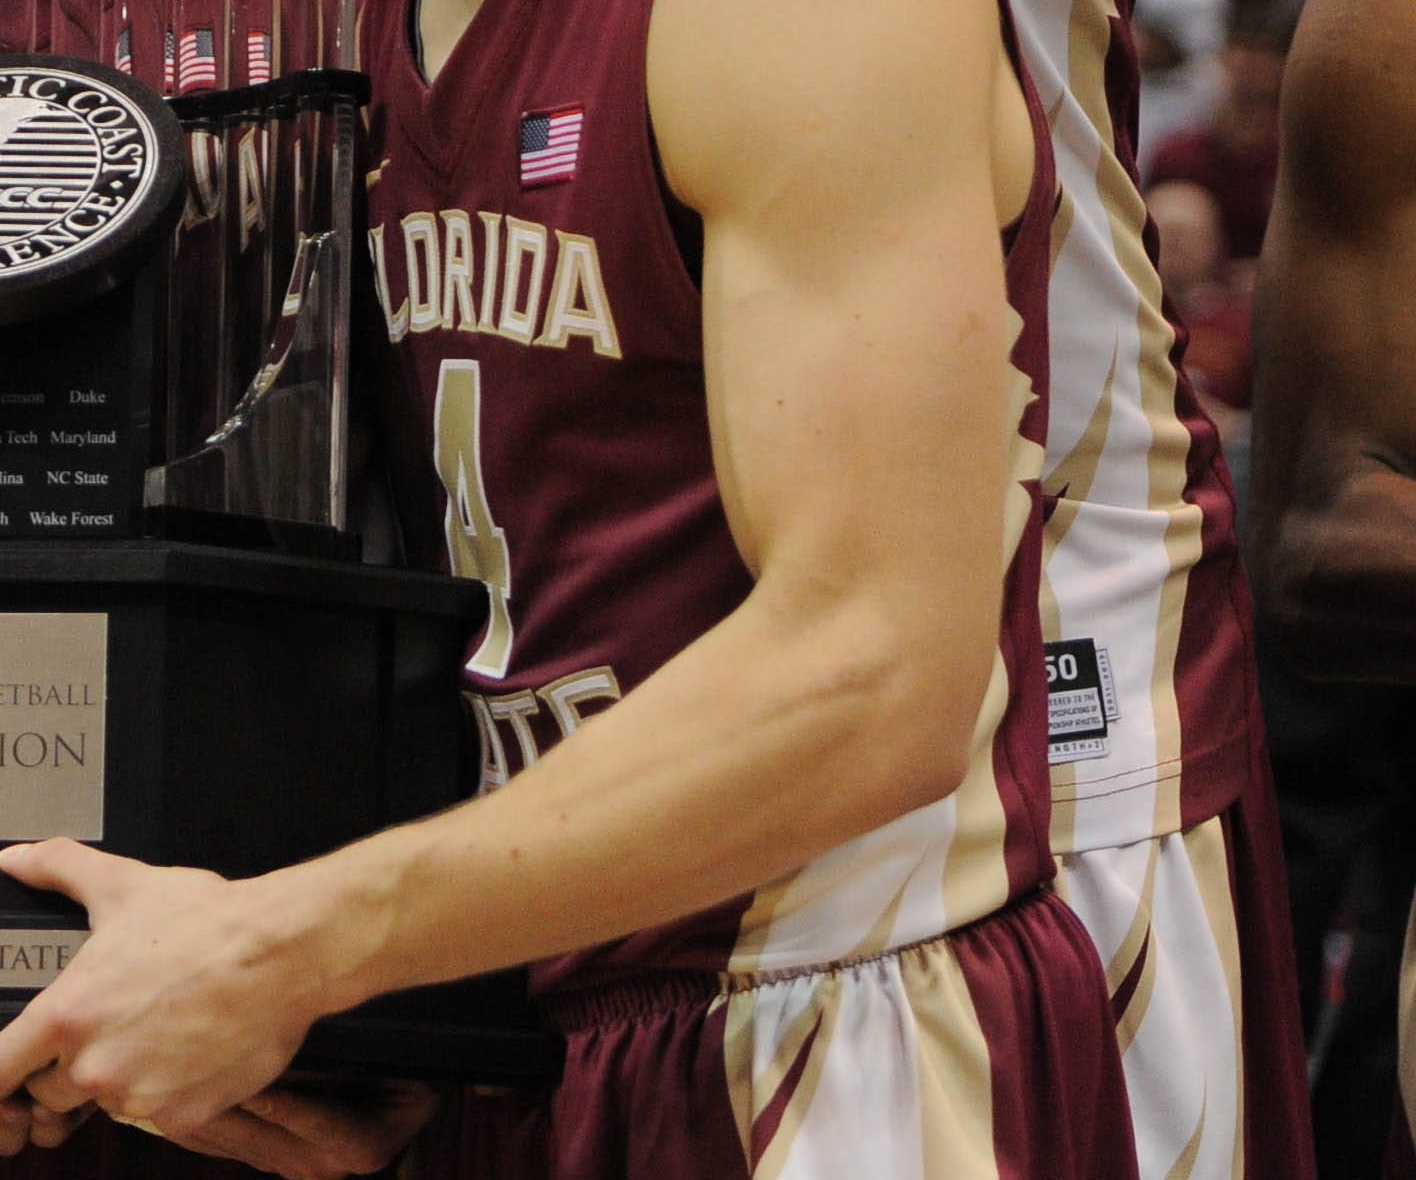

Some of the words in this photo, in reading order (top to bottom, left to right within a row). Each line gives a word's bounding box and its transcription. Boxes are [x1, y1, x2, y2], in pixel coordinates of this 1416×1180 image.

[68, 91, 143, 178] COAST
[368, 210, 623, 359] LORIDA
[70, 389, 106, 404] Duke
[6, 431, 38, 445] Tech
[50, 430, 116, 447] Maryland
[47, 471, 71, 485] NC
[74, 471, 109, 485] State
[30, 512, 67, 526] Wake
[71, 512, 114, 526] Forest
[434, 359, 514, 679] 4
[1044, 653, 1079, 683] 50
